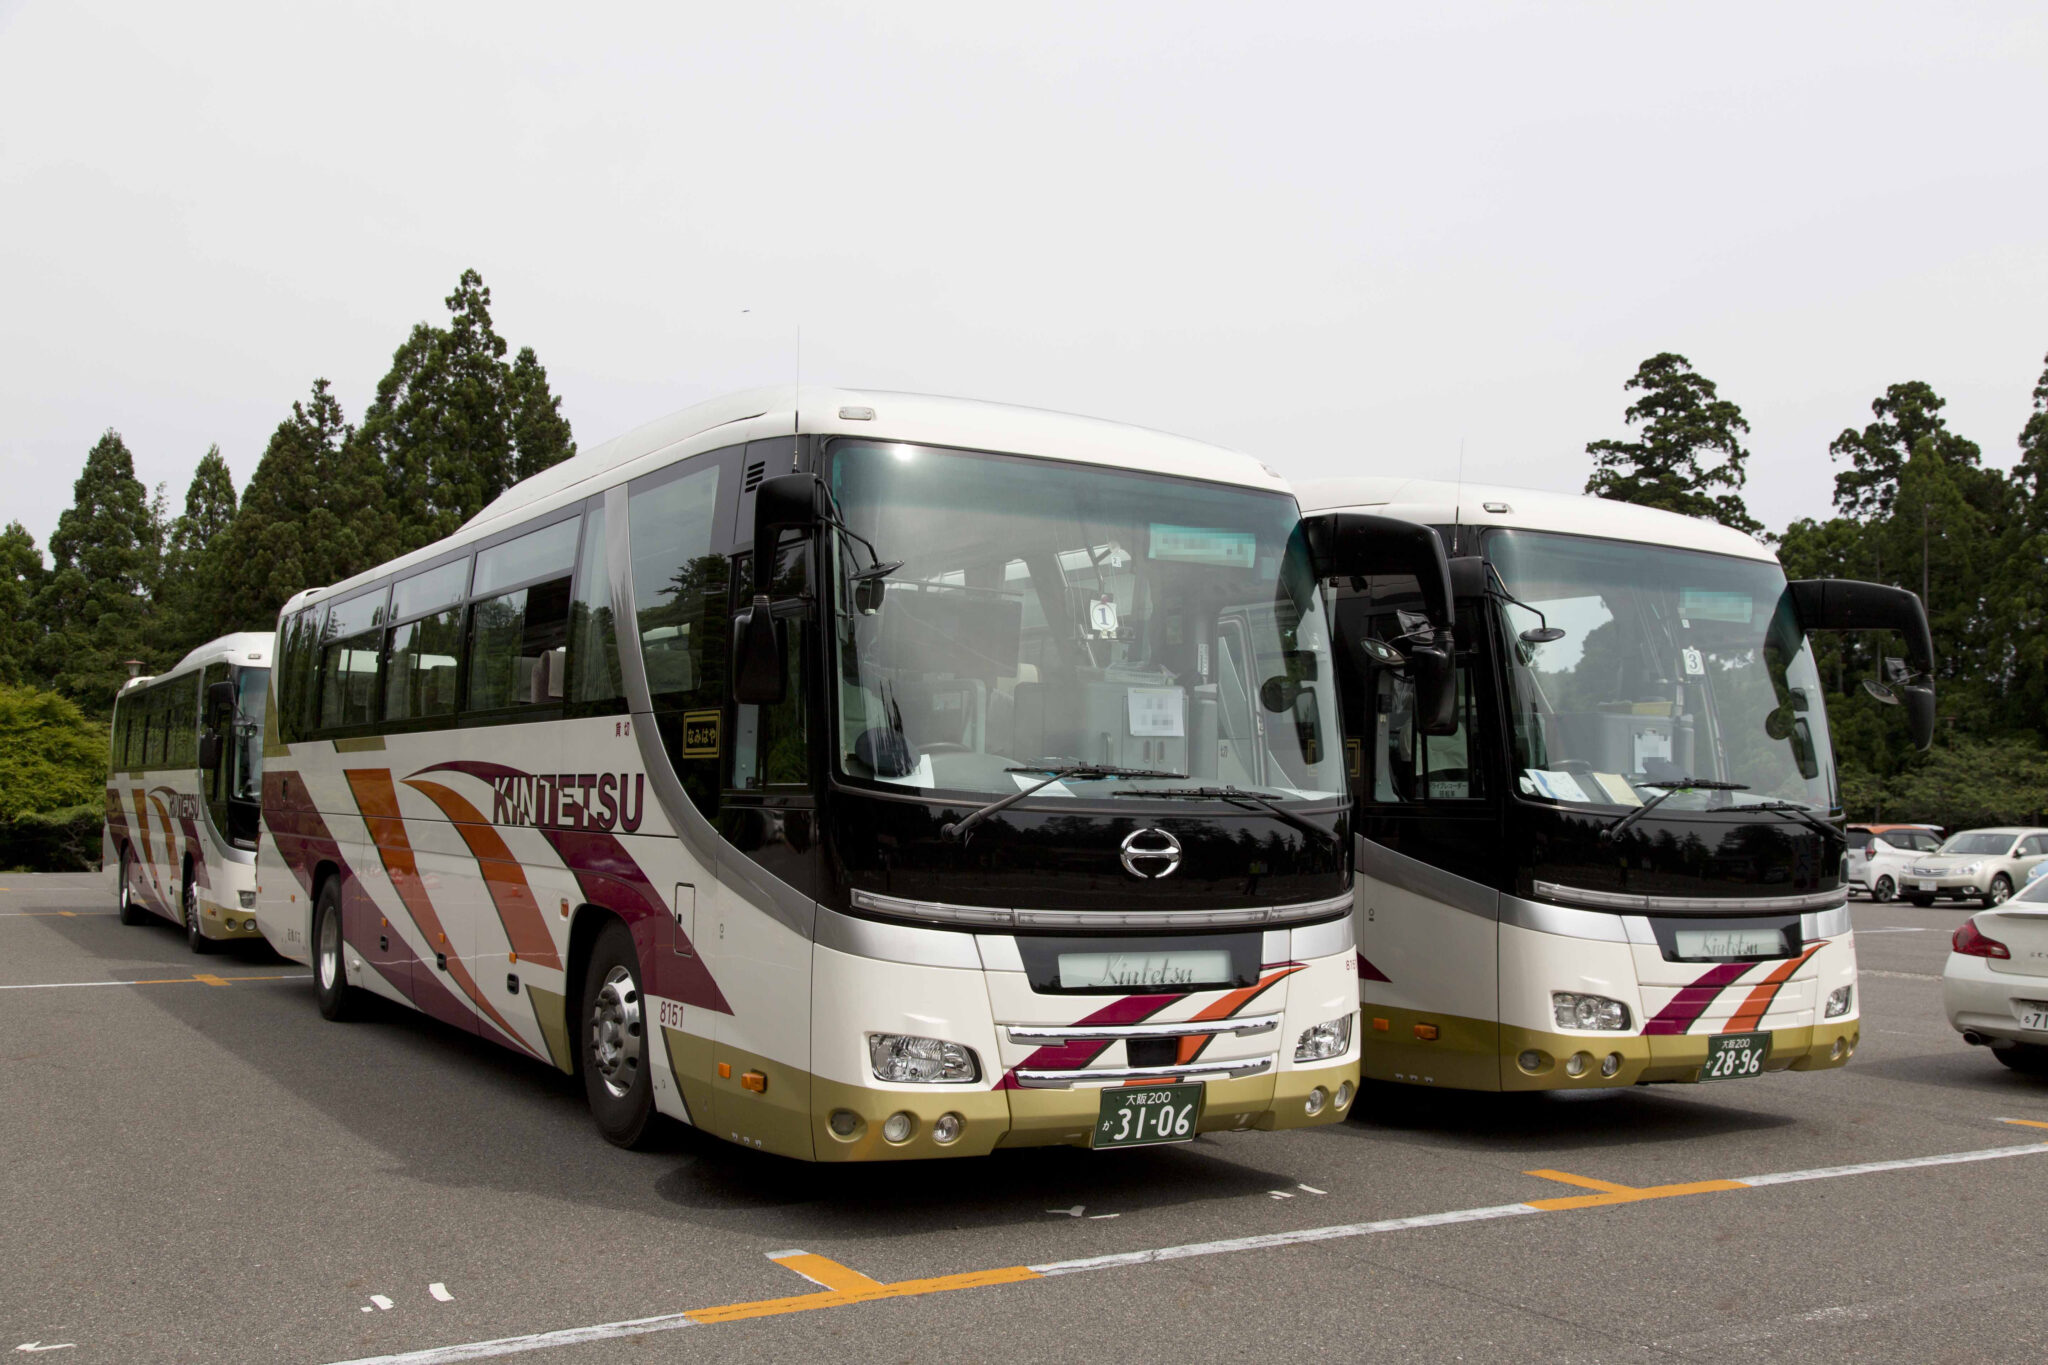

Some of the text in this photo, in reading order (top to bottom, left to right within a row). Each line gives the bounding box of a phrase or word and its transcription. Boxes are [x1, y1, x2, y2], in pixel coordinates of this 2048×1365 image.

[616, 721, 630, 737] 貸切
[687, 727, 716, 744] なみはや
[493, 772, 645, 833] KINTETSU
[1090, 953, 1193, 986] Kintetsu
[660, 1001, 684, 1028] 8151
[1711, 1048, 1763, 1076] 28-96
[1125, 1091, 1171, 1106] 大阪200
[1102, 1103, 1193, 1140] か 31-06
